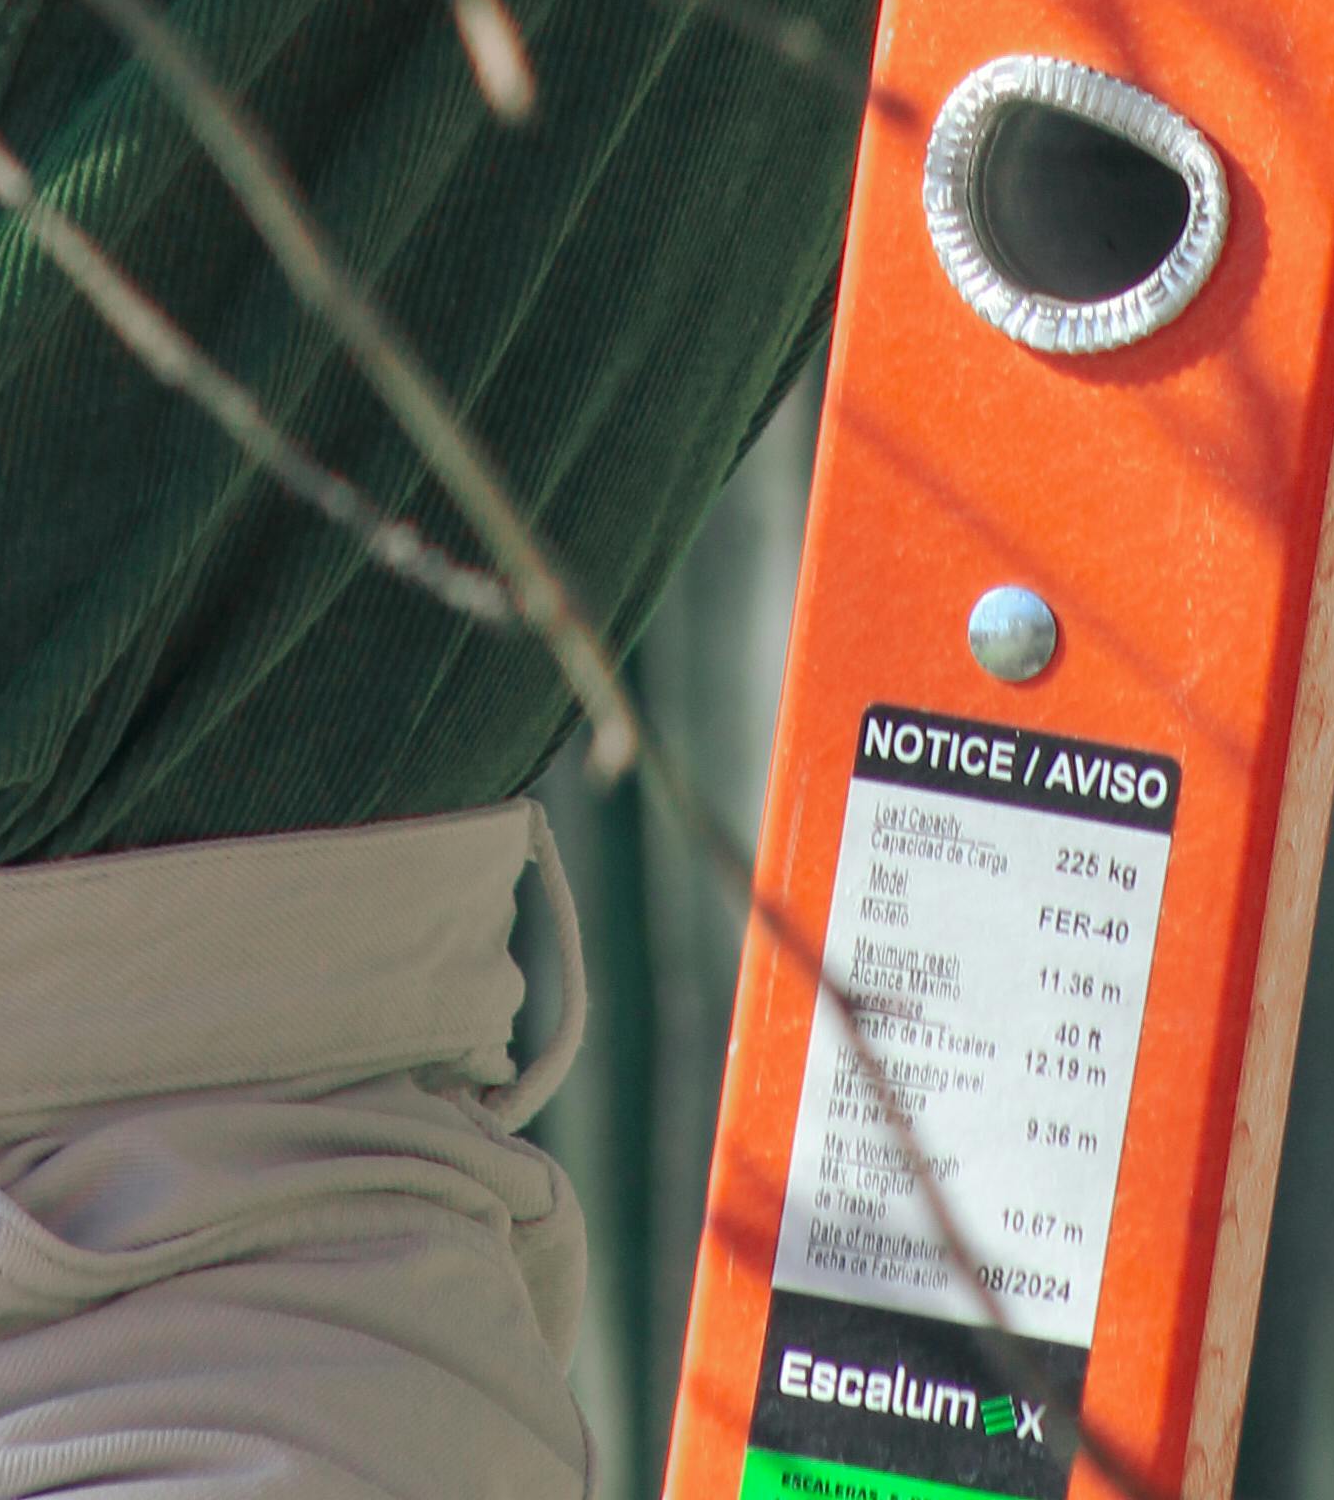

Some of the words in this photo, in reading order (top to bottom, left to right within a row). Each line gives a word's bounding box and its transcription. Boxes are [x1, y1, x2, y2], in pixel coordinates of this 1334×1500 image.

[861, 717, 1016, 781] NOTICE
[1022, 746, 1040, 786] /
[1044, 750, 1171, 809] AVISO
[1107, 856, 1138, 891] kg
[1038, 906, 1129, 945] FER-40
[1037, 968, 1094, 998] 11.36
[1101, 985, 1121, 1003] m
[1054, 1021, 1080, 1046] 40
[1087, 1027, 1102, 1049] ft
[834, 1045, 888, 1079] Higst
[1024, 1051, 1080, 1081] 12.19
[1086, 1067, 1106, 1086] m
[1026, 1119, 1071, 1147] 9.36
[1077, 1133, 1097, 1153] m
[1001, 1206, 1056, 1238] 10.67
[1062, 1223, 1084, 1244] m
[975, 1263, 1072, 1305] 08/2024
